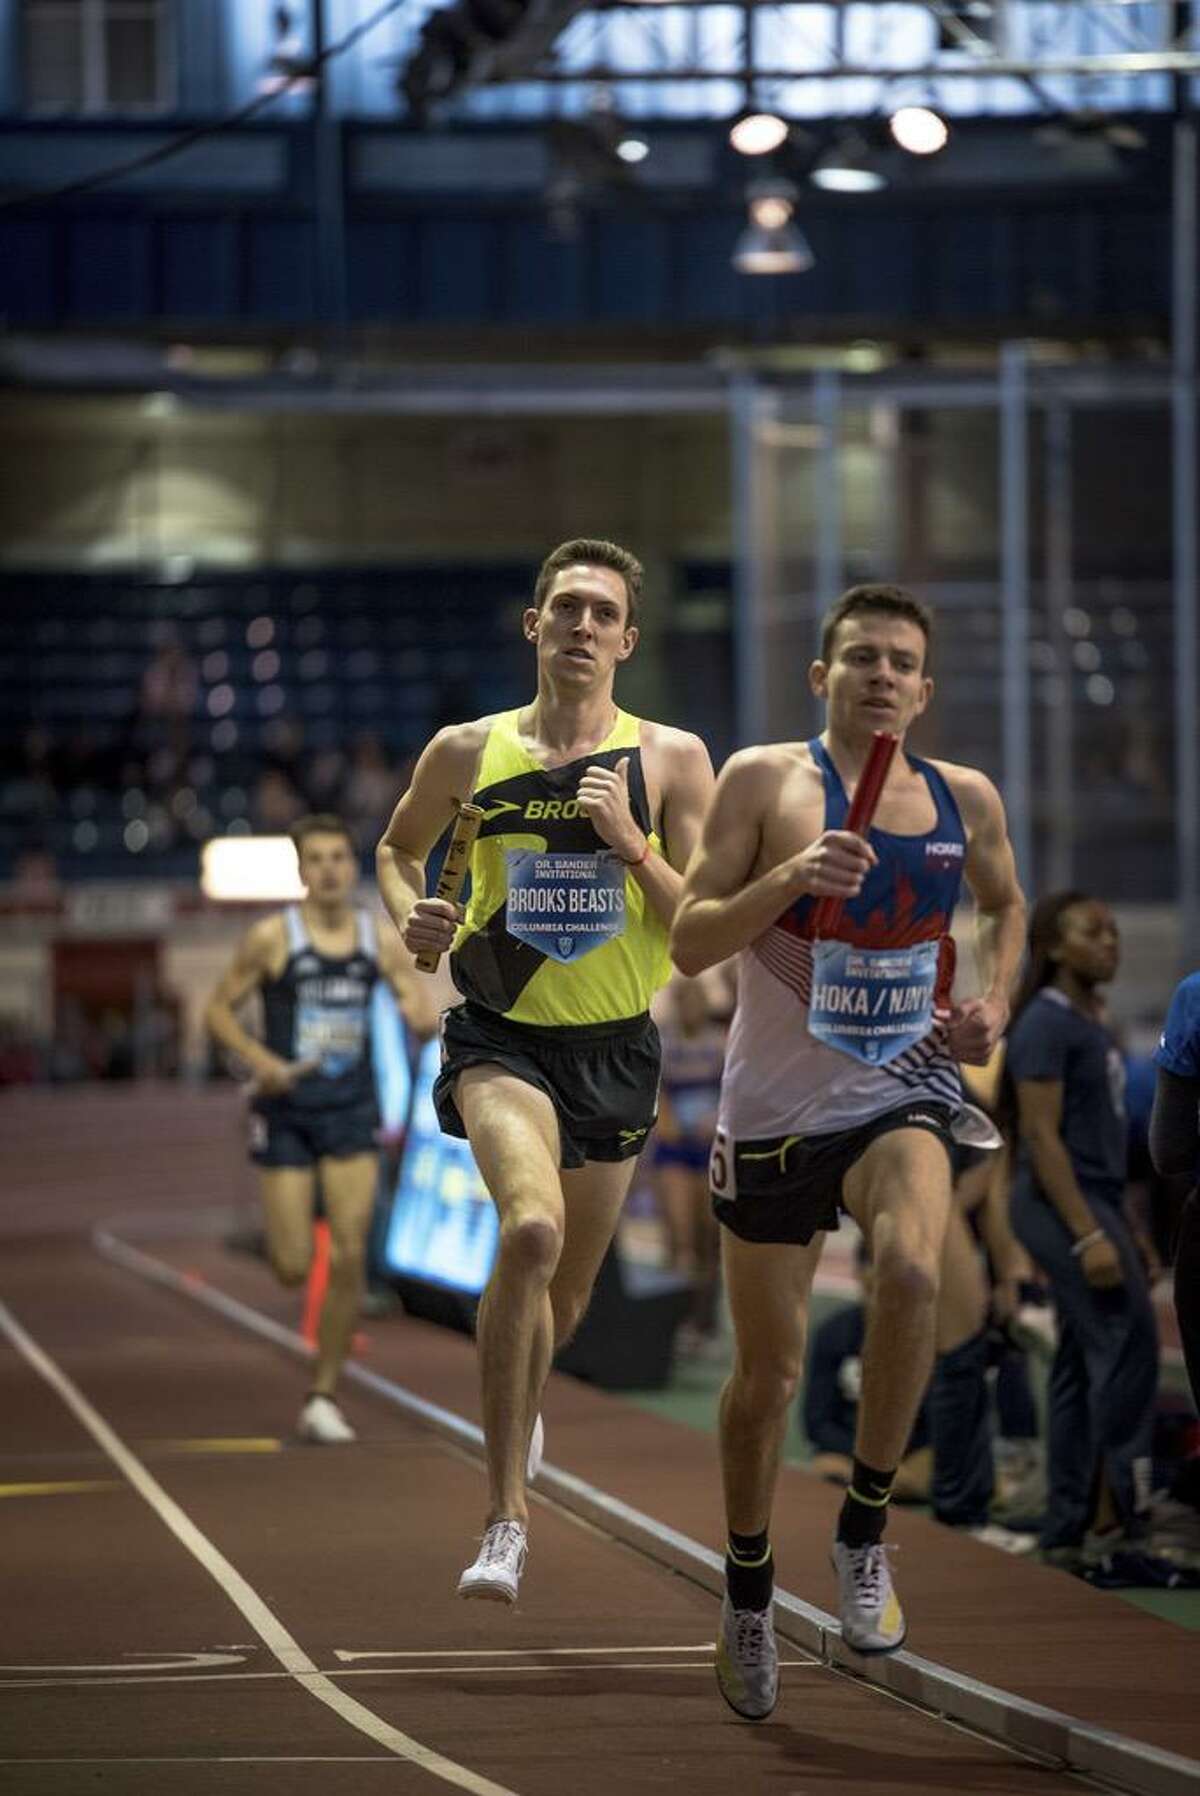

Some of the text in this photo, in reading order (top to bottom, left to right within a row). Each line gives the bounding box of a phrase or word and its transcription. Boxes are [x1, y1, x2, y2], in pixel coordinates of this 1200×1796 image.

[508, 887, 625, 913] BROOKS BEASTS
[812, 984, 869, 1016] HOKA
